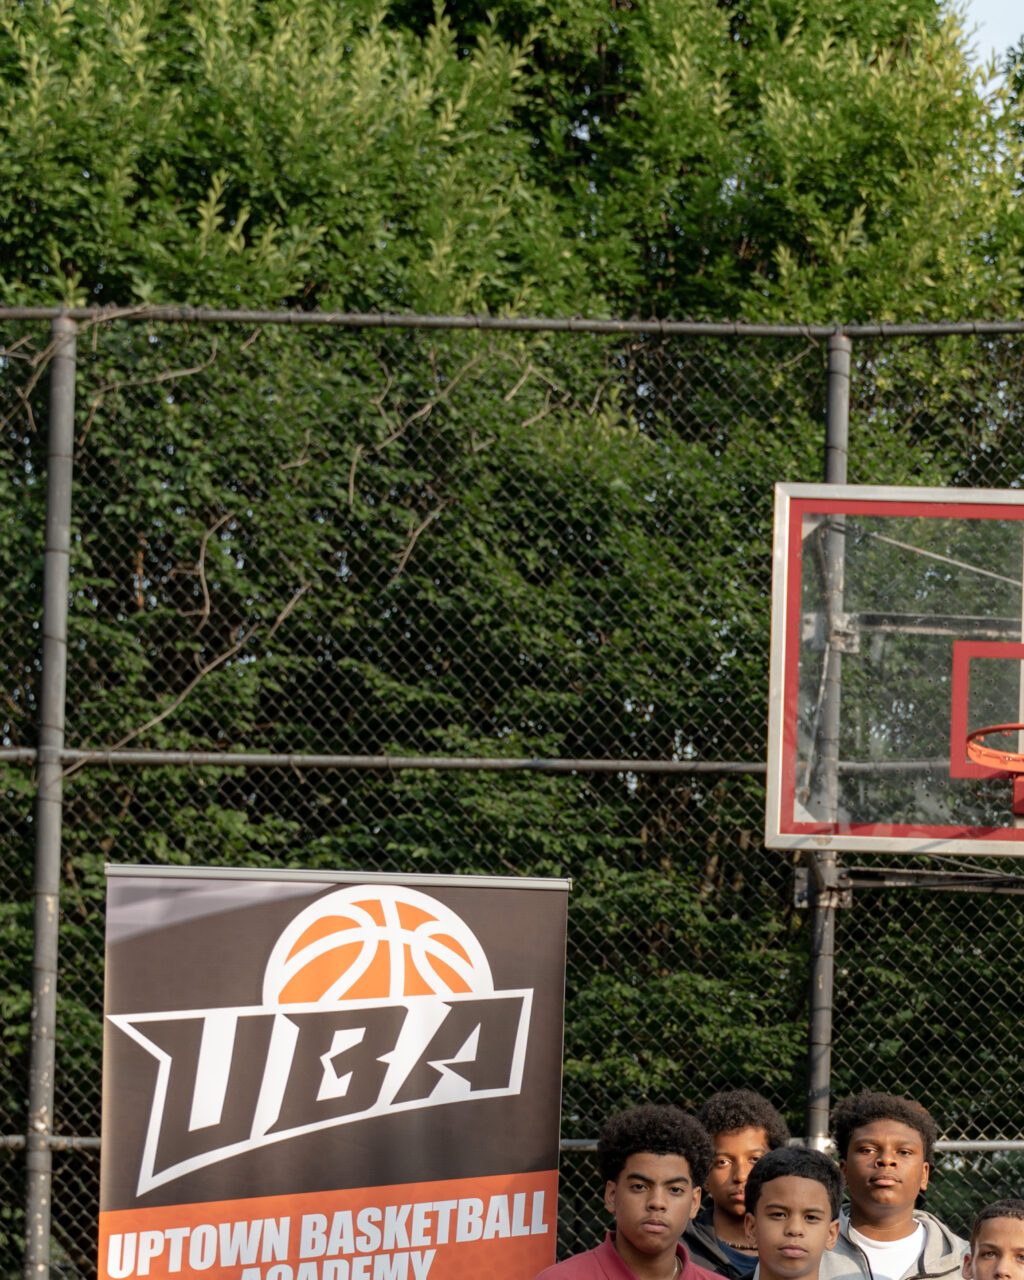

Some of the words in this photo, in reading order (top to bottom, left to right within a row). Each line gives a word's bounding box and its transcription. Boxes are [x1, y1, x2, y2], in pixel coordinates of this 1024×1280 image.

[106, 989, 534, 1198] UBA
[106, 1217, 290, 1279] UPTOWN
[300, 1190, 549, 1257] BASKETBALL
